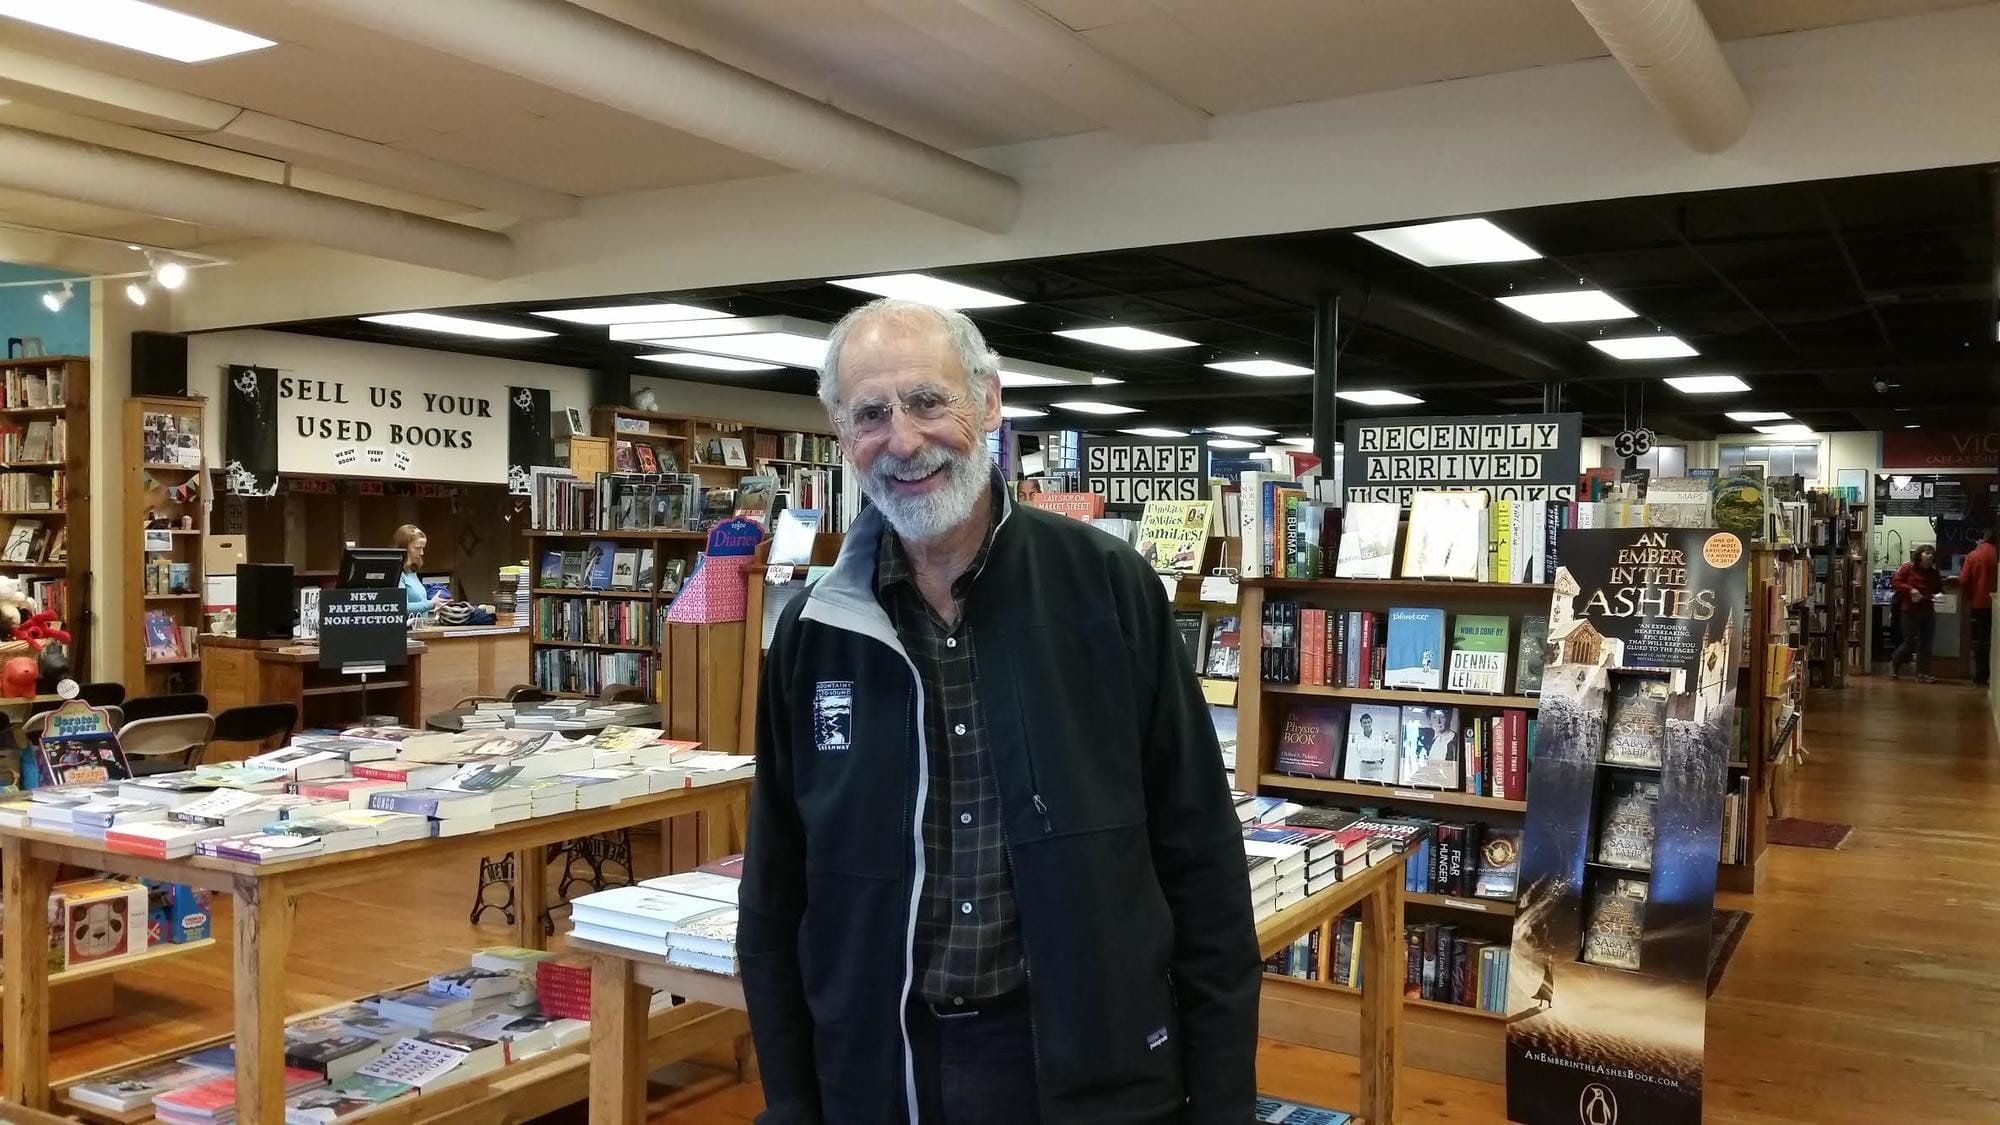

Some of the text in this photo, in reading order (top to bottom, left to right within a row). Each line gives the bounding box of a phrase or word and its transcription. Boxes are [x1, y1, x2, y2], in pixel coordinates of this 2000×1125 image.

[279, 377, 492, 418] SELL US YOUR
[296, 415, 473, 450] USED BOOKS
[1361, 425, 1556, 450] RECENTLY
[1091, 447, 1196, 471] STAFF
[1369, 456, 1539, 479] ARRIVED
[1090, 478, 1196, 502] PICKS
[1350, 487, 1437, 509] USE
[1039, 502, 1090, 511] MARKET STREET
[714, 530, 758, 547] Diaries
[1287, 517, 1296, 555] BURMA
[1629, 532, 1669, 547] AN
[1618, 549, 1686, 565] EMBER
[1609, 566, 1688, 586] IN THE
[350, 592, 379, 601] NEW
[1579, 586, 1715, 620] ASHES
[328, 604, 399, 613] PAPERBACK
[323, 615, 404, 625] NON-FICTION
[1460, 626, 1480, 636] WORLD
[1480, 627, 1495, 636] GONE
[1454, 653, 1498, 670] DENNIS
[54, 714, 100, 727] Scratch
[1285, 721, 1320, 734] Physics
[1284, 732, 1316, 745] BOOK
[1615, 737, 1653, 749] SABAA
[1621, 747, 1649, 756] TAHIR
[372, 796, 395, 811] CONGO
[1610, 838, 1648, 851] SABAA
[1438, 843, 1448, 883] HUNGER
[1450, 849, 1461, 876] FEAR
[1438, 937, 1447, 951] City
[1595, 936, 1632, 950] SABAA
[1600, 947, 1628, 957] TAHIR
[1438, 957, 1446, 971] Lost
[1438, 971, 1446, 987] Souls
